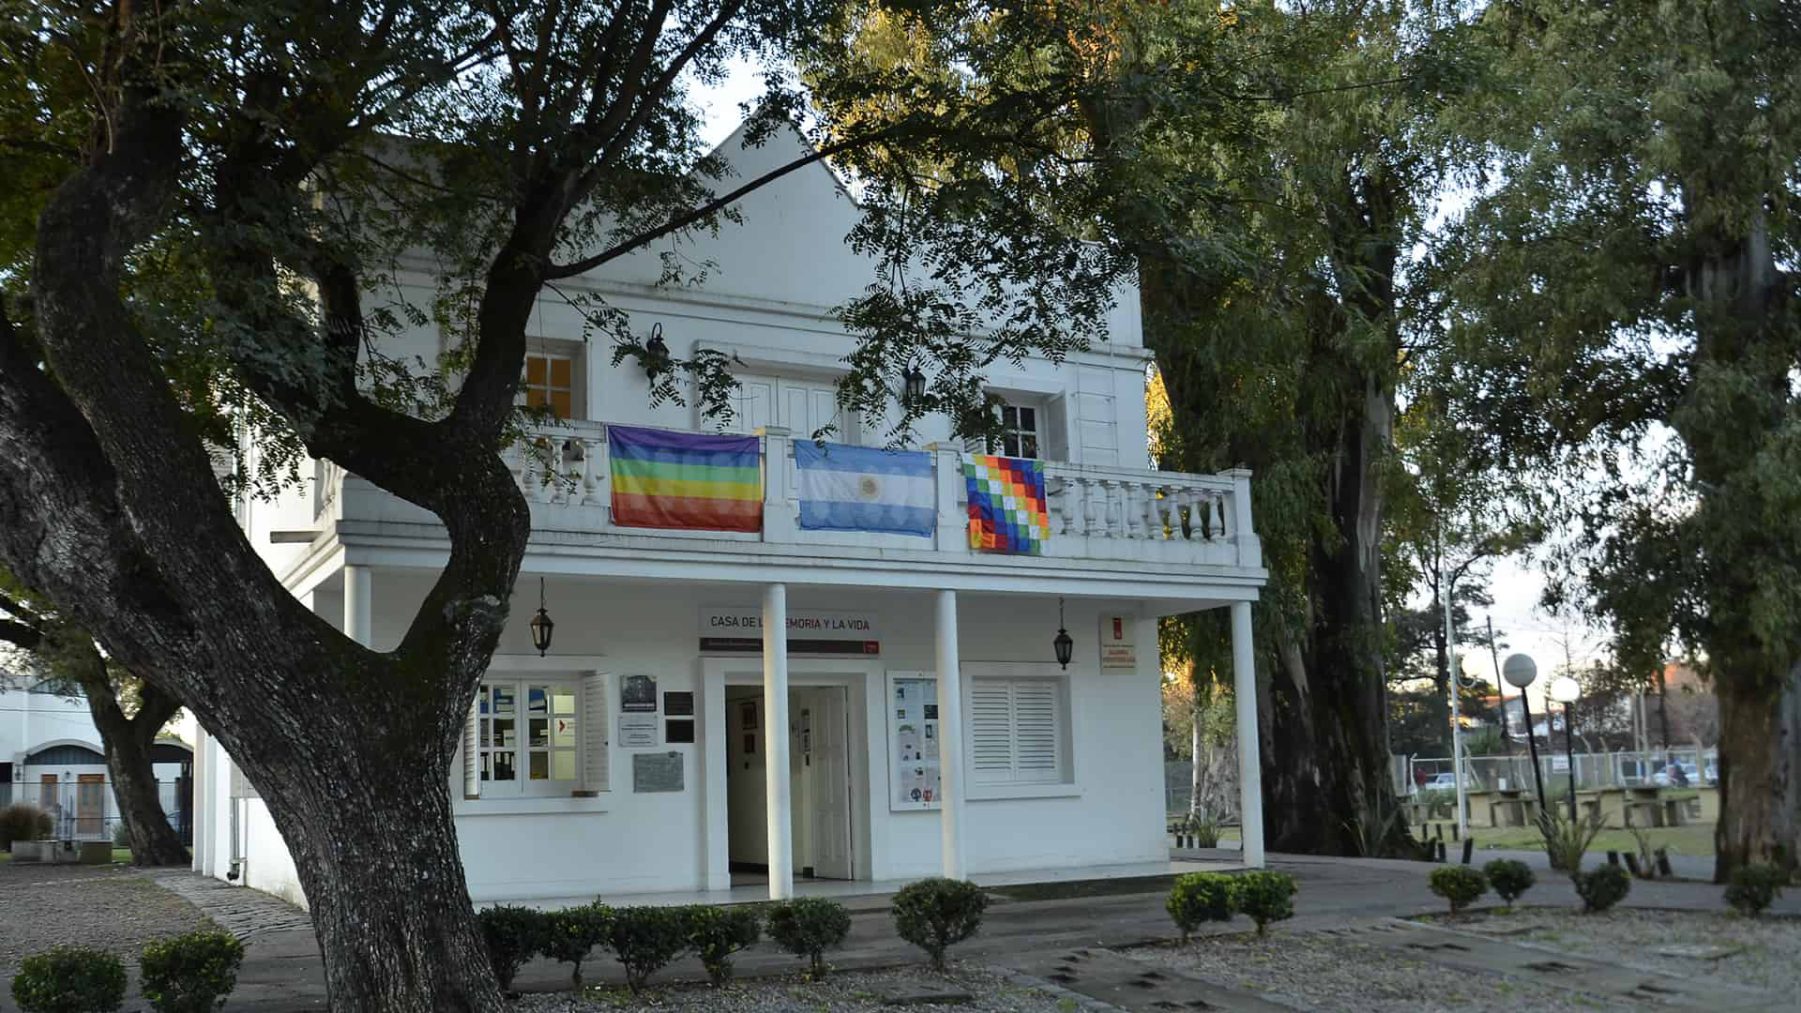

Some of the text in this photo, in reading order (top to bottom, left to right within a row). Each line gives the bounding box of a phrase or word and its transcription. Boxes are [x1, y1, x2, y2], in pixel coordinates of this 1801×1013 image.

[711, 616, 740, 627] CASA
[742, 616, 756, 627] DE
[786, 617, 821, 629] EMORIA
[824, 618, 830, 629] Y
[832, 619, 845, 629] LA
[847, 619, 870, 630] VIDA
